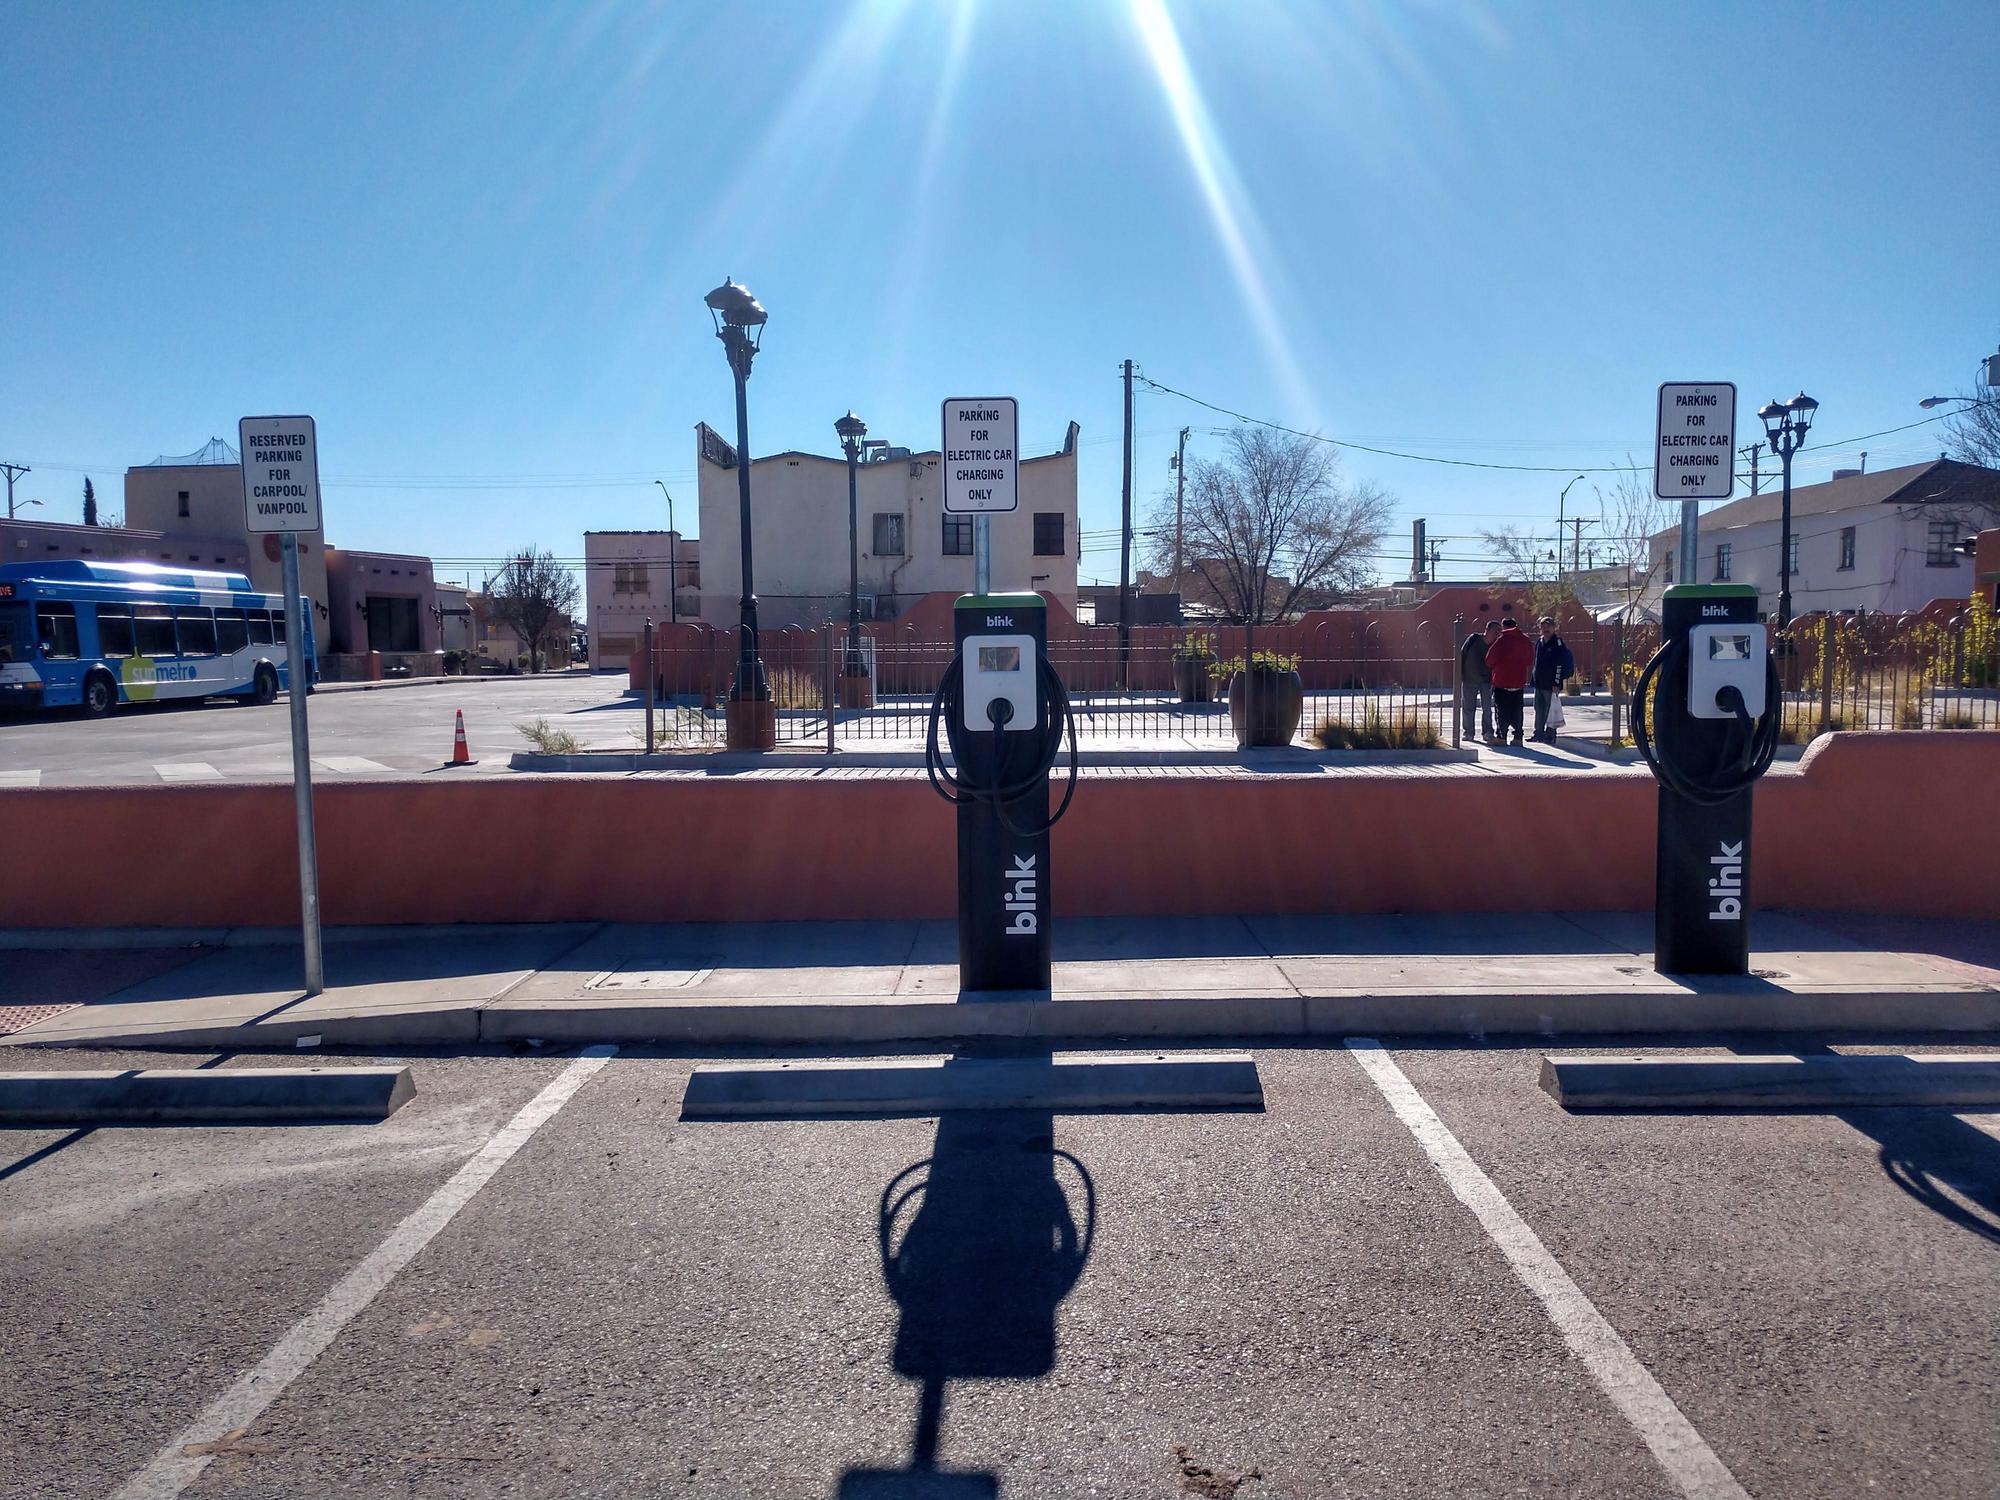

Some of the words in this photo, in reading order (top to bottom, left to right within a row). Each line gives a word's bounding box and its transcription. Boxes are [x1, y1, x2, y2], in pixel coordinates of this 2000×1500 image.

[1676, 395, 1717, 406] PARKING
[959, 410, 999, 421] PARKING
[1686, 415, 1705, 426] FOR
[249, 434, 306, 446] RESERVED
[970, 430, 989, 441] FOR
[1662, 435, 1707, 447] ELECTRIC
[1709, 435, 1729, 446] CAR
[255, 450, 302, 462] PARKING
[947, 450, 992, 461] ELECTRIC
[993, 449, 1012, 460] CAR
[1669, 455, 1719, 467] CHARGING
[268, 469, 291, 481] FOR
[956, 469, 1004, 481] CHARGING
[1681, 475, 1706, 487] ONLY
[253, 484, 308, 497] CARPOOL/
[968, 489, 993, 501] ONLY
[256, 502, 308, 515] VANPOOL
[1702, 605, 1729, 617] blink
[986, 616, 1014, 627] blink
[1708, 840, 1742, 920] blink
[1004, 854, 1037, 935] blink
